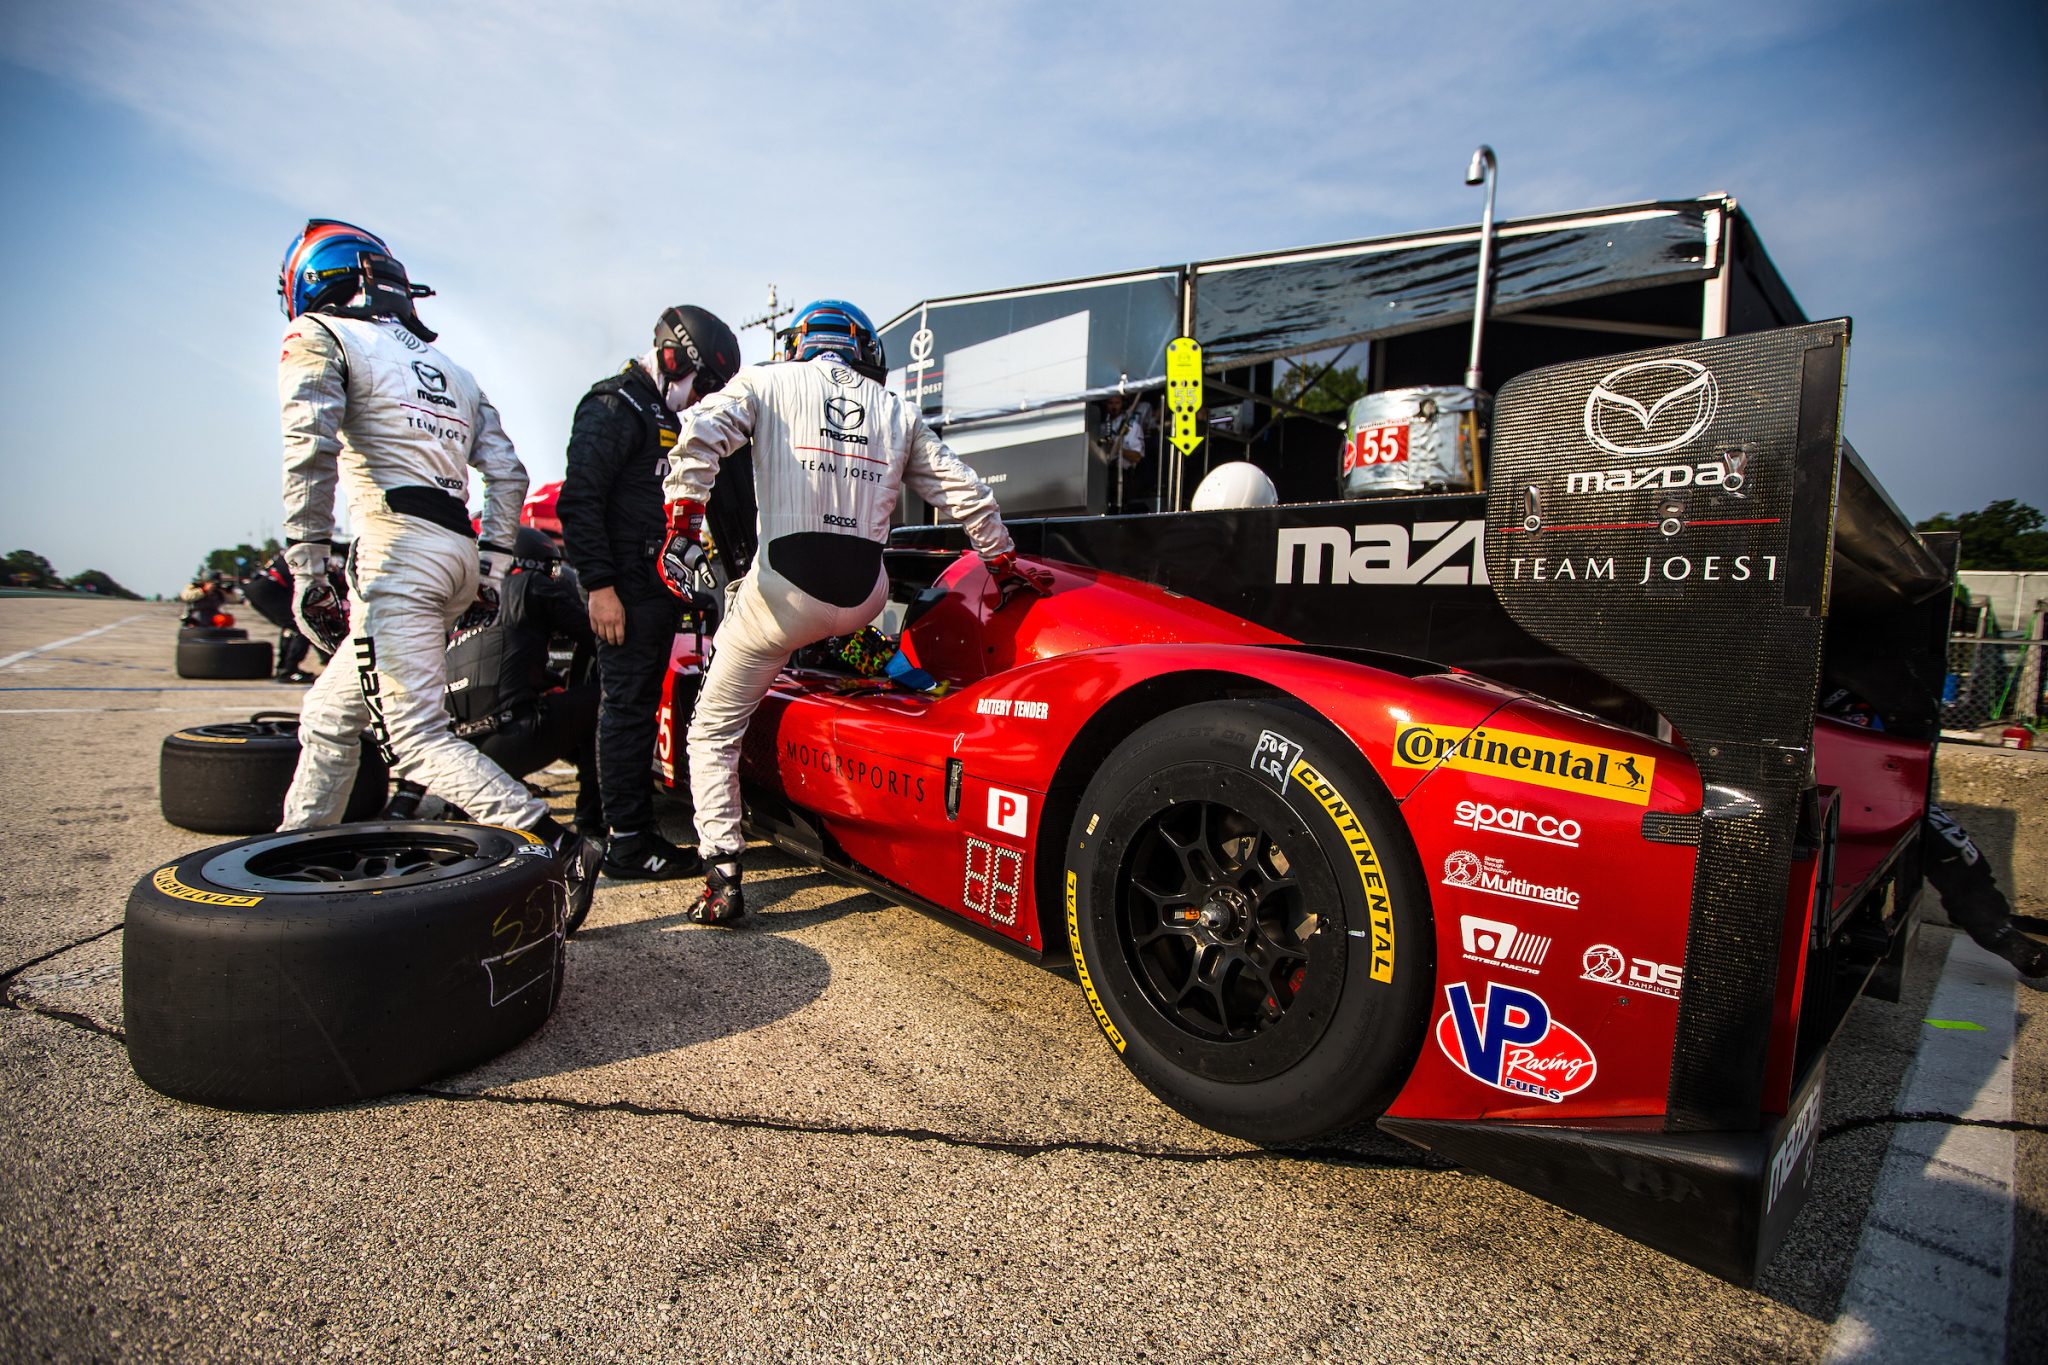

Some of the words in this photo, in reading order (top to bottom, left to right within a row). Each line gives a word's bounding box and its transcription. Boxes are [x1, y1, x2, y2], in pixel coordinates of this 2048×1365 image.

[674, 323, 705, 371] uvex
[1175, 388, 1196, 405] 55
[820, 428, 868, 445] mazda
[1363, 427, 1399, 464] 55
[800, 460, 837, 473] TEAM
[843, 467, 883, 483] JOEST
[1567, 462, 1732, 493] mazda
[823, 514, 857, 528] sparco
[1275, 519, 1491, 585] maz
[1510, 557, 1615, 582] TEAM
[353, 636, 400, 767] mazda
[976, 699, 1012, 716] BATTERY
[1014, 700, 1049, 720] TENDER
[1259, 757, 1283, 782] LR
[1397, 726, 1609, 785] Continental
[786, 741, 925, 802] MOTORSPORTS
[997, 795, 1016, 826] P
[1455, 800, 1582, 843] sparco
[1298, 767, 1392, 974] CONTINENTAL
[1481, 871, 1580, 905] Multimatic
[1067, 878, 1122, 1045] CONTINENTAL
[1462, 953, 1500, 966] MOTEGI
[1500, 962, 1540, 975] RACING
[1628, 980, 1671, 995] DAMPING
[1446, 981, 1550, 1087] VP
[1507, 1049, 1590, 1081] Racing
[1506, 1078, 1560, 1100] FUELS
